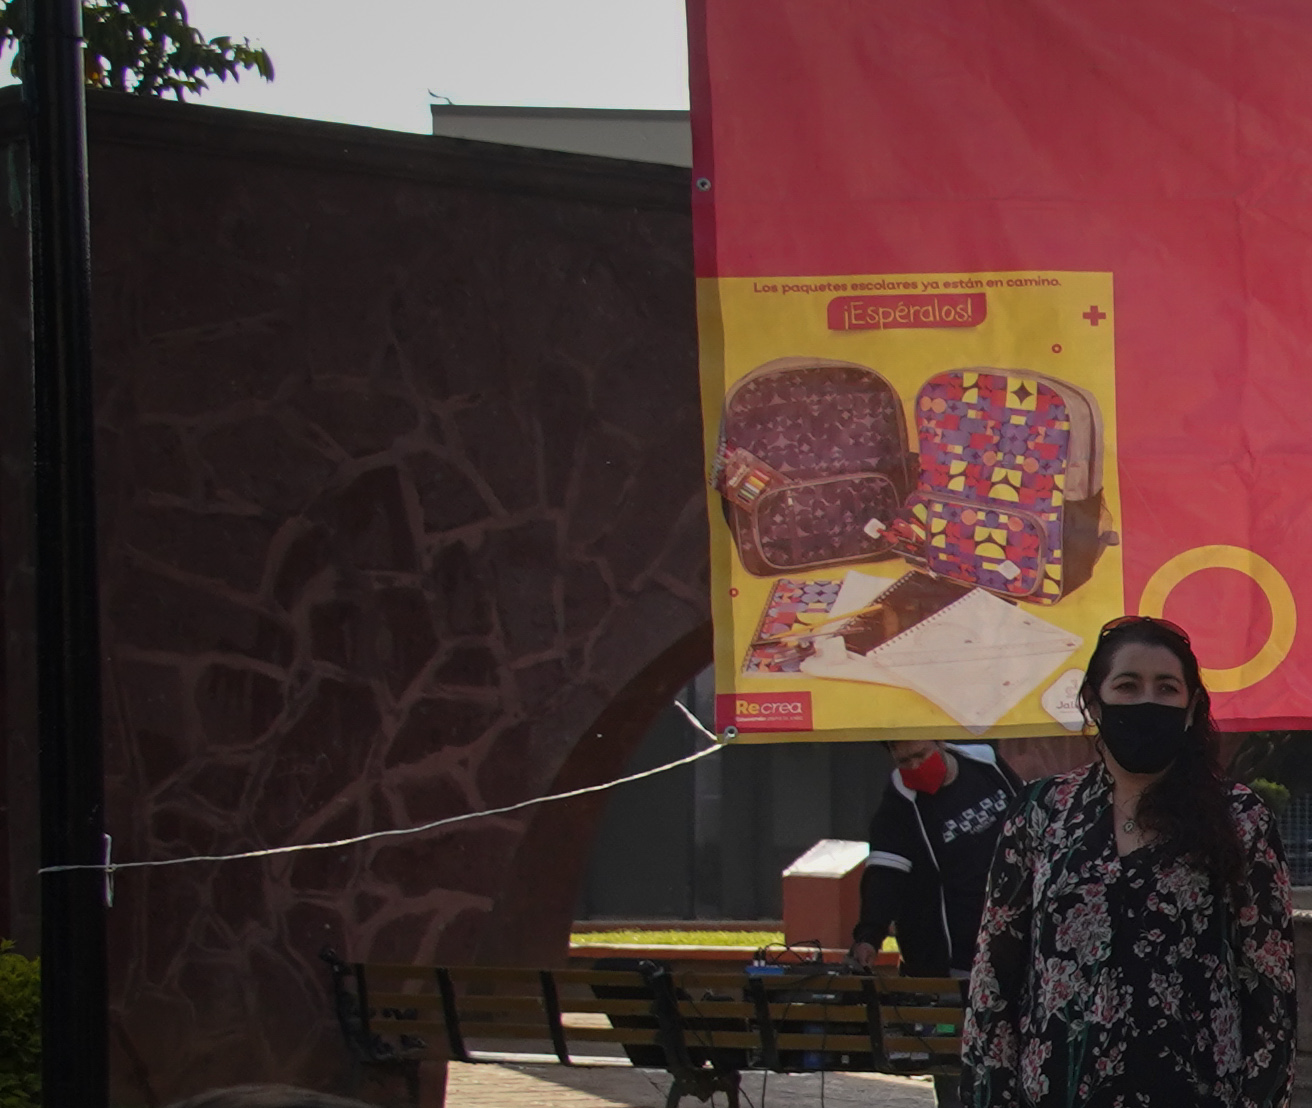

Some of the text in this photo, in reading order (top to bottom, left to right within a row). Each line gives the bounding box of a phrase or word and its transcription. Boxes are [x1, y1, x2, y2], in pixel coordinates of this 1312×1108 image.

[753, 275, 1062, 295] Los paquetes escolares ya están en camino.
[841, 297, 974, 331] ¡Espéralos!
[736, 699, 803, 715] Recrea
